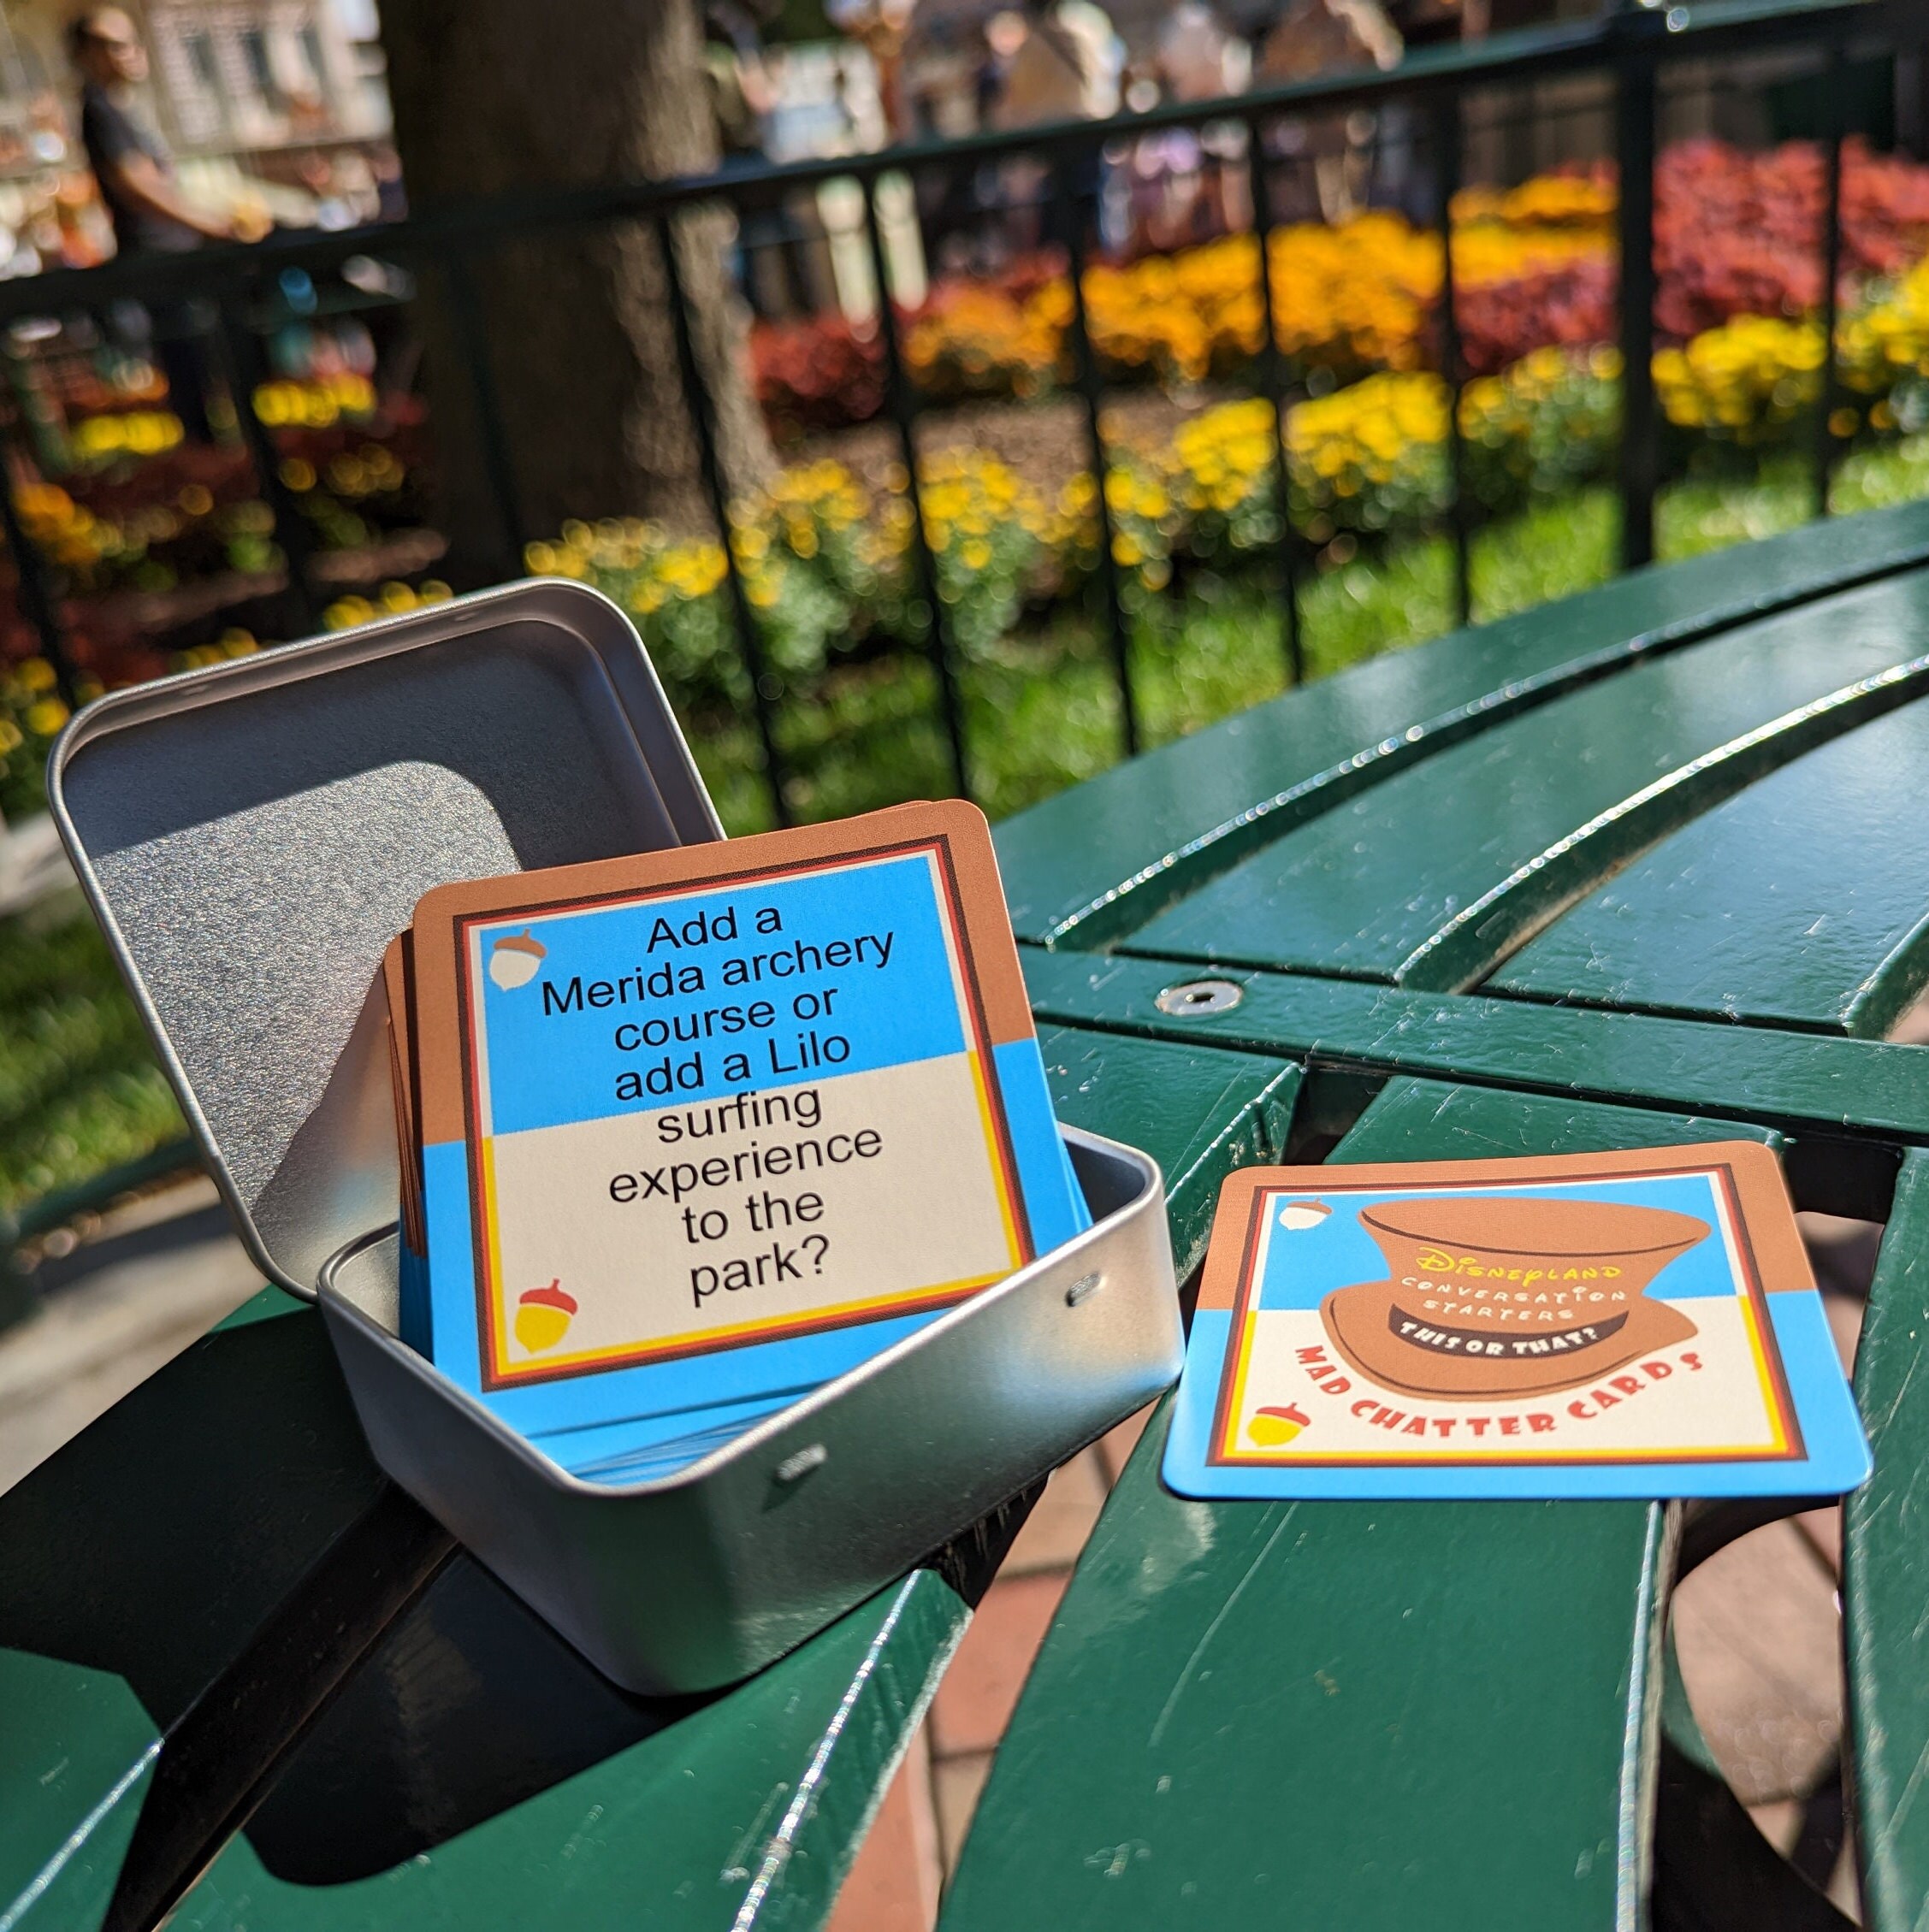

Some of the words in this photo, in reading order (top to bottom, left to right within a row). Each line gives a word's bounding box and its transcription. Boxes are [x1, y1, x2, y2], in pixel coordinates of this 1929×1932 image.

[646, 907, 737, 954] Add
[755, 907, 783, 934] a
[542, 960, 705, 1016] Merida
[721, 931, 894, 986] archery
[615, 999, 776, 1052] course
[793, 985, 837, 1020] or
[615, 1052, 704, 1101] add
[723, 1054, 751, 1082] a
[768, 1031, 849, 1074] Lilo
[657, 1089, 822, 1144] surfing
[608, 1129, 882, 1203] experience
[681, 1207, 729, 1244] to
[745, 1191, 824, 1232] the
[690, 1233, 830, 1309] park?
[1401, 1277, 1626, 1303] CONVERSATION
[1399, 1321, 1463, 1350] THIS
[1465, 1339, 1506, 1356] OR
[1512, 1326, 1599, 1355] THAT?
[1423, 1299, 1574, 1321] STARTERS
[1294, 1344, 1352, 1396] MAD
[1351, 1399, 1558, 1438] CHATTER
[1566, 1351, 1704, 1420] CARDS
